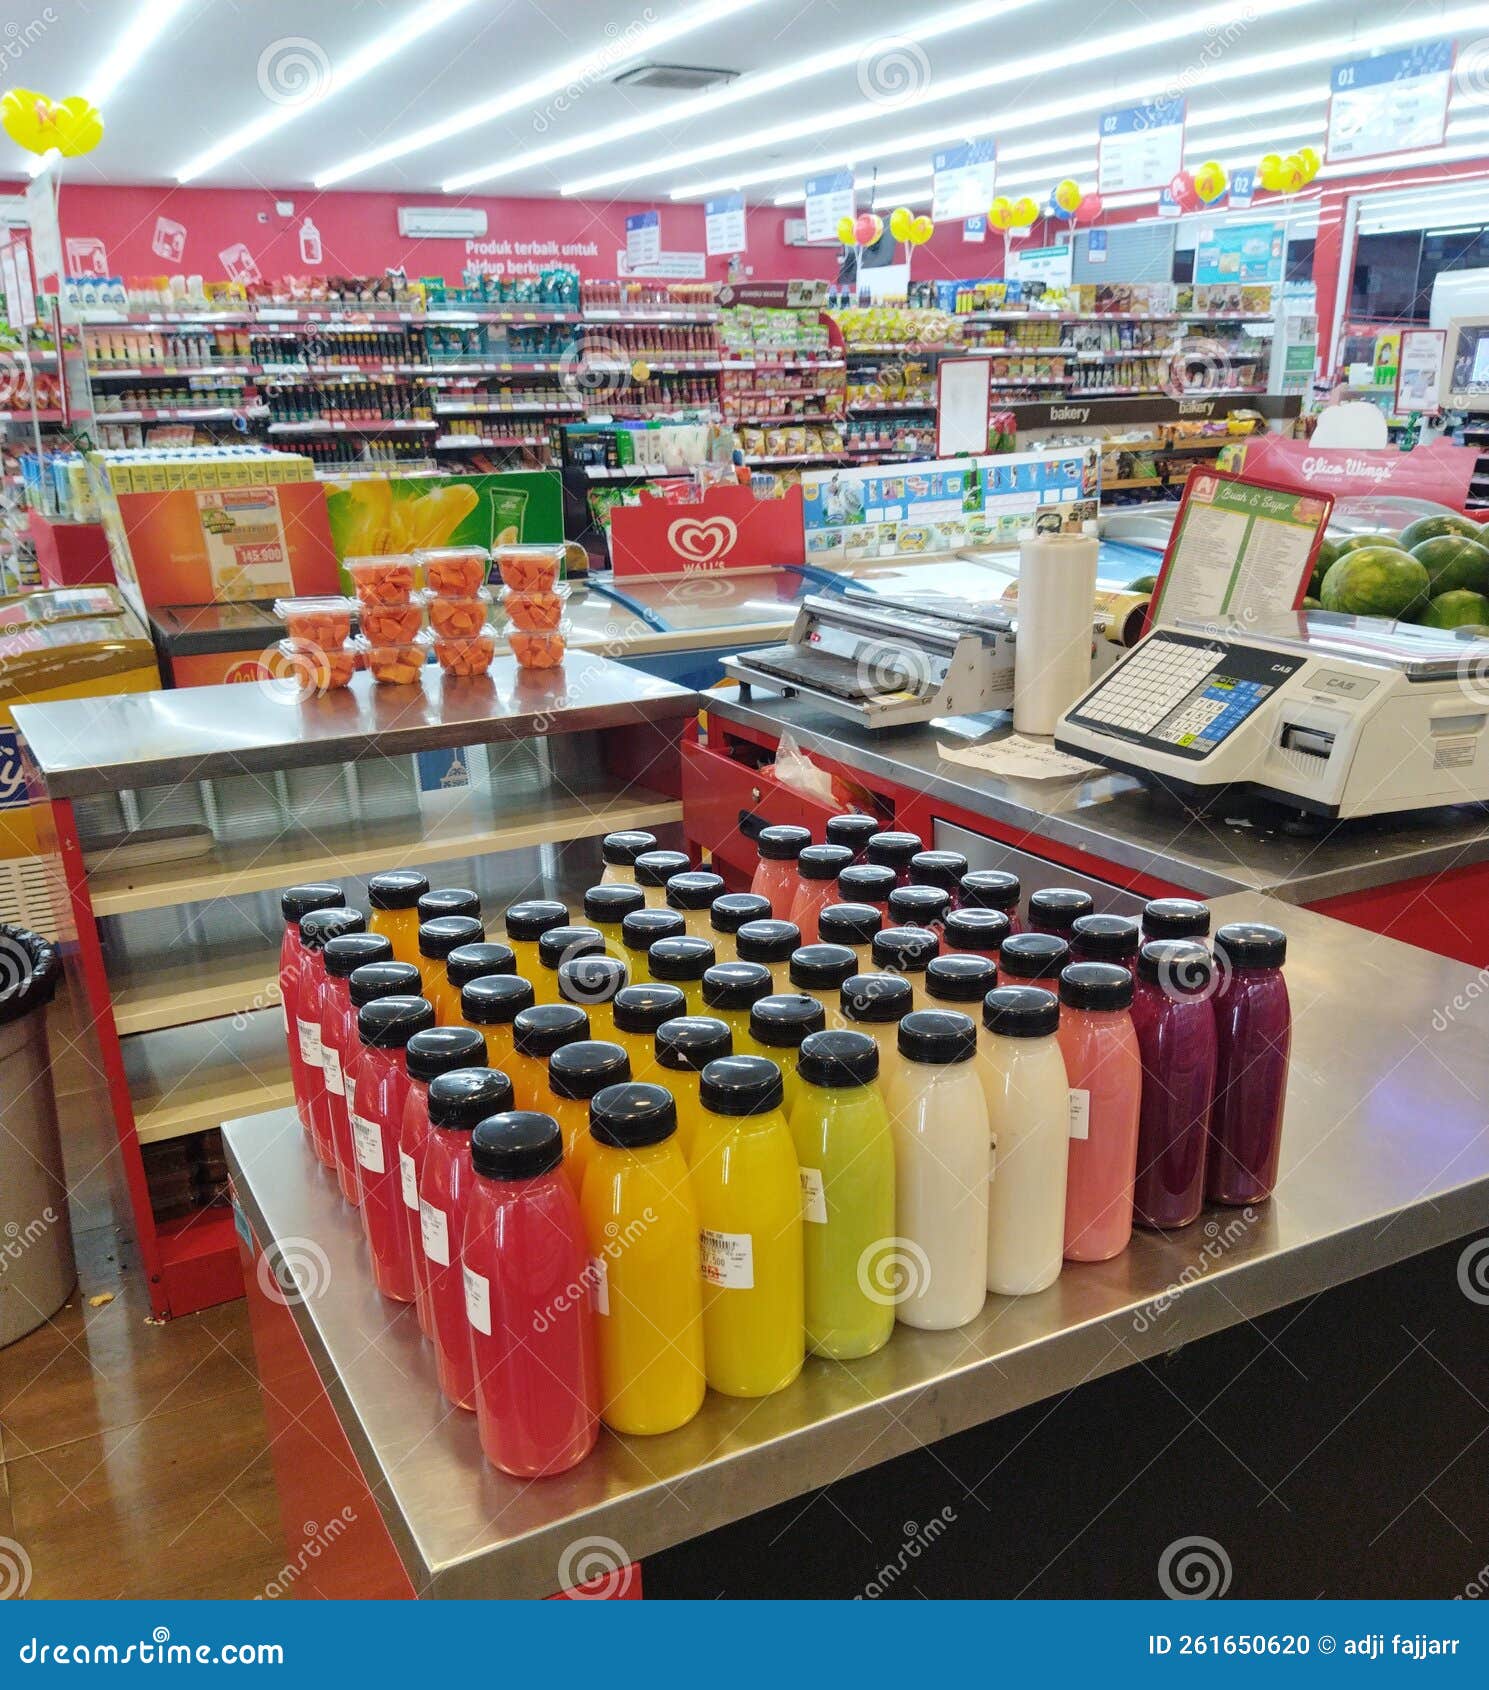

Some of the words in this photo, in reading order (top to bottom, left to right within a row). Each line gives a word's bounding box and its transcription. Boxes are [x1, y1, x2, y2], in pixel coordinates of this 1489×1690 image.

[1338, 67, 1355, 86] 01
[1104, 116, 1118, 132] 02
[1234, 176, 1249, 193] 02
[465, 240, 512, 256] Produk
[514, 240, 559, 256] terbaik
[562, 242, 598, 256] untuk
[467, 259, 504, 276] hidup
[1050, 406, 1090, 422] bakery
[1179, 401, 1215, 416] bakery
[1302, 456, 1344, 481] Glico
[1261, 496, 1291, 513] Sayur
[1271, 663, 1293, 674] CAS
[1326, 679, 1355, 691] CAS
